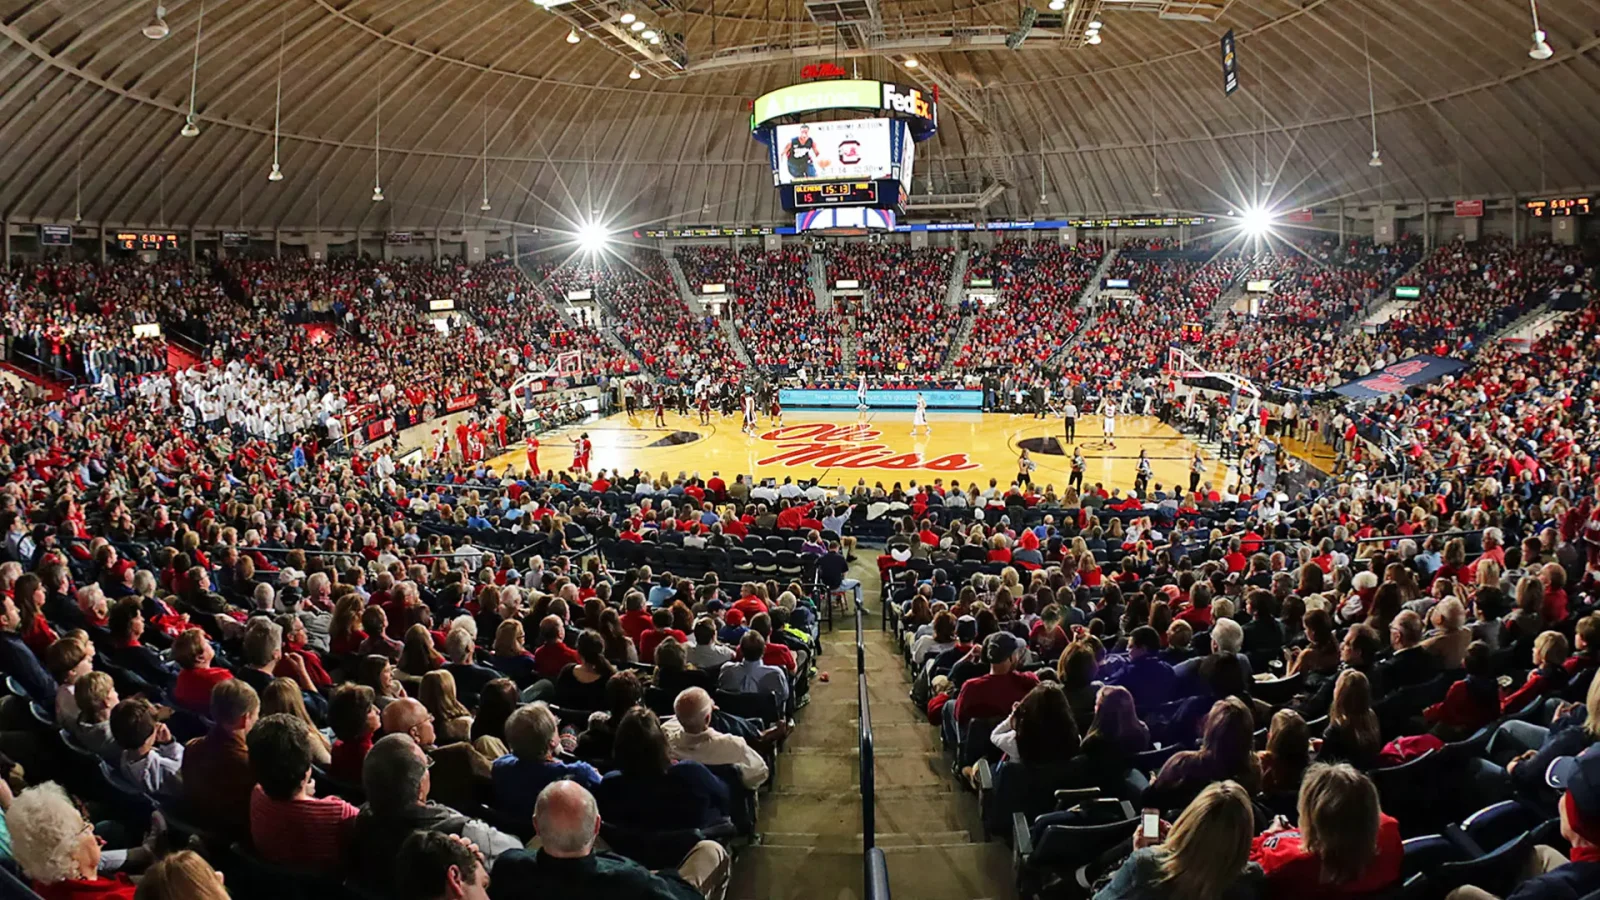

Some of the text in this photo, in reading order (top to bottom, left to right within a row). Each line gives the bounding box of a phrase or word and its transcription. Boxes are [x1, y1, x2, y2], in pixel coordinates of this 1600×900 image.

[883, 83, 930, 118] FedEx
[804, 190, 875, 202] 15 7
[826, 184, 848, 194] 15:13
[759, 423, 881, 442] Ole
[757, 442, 981, 471] Miss
